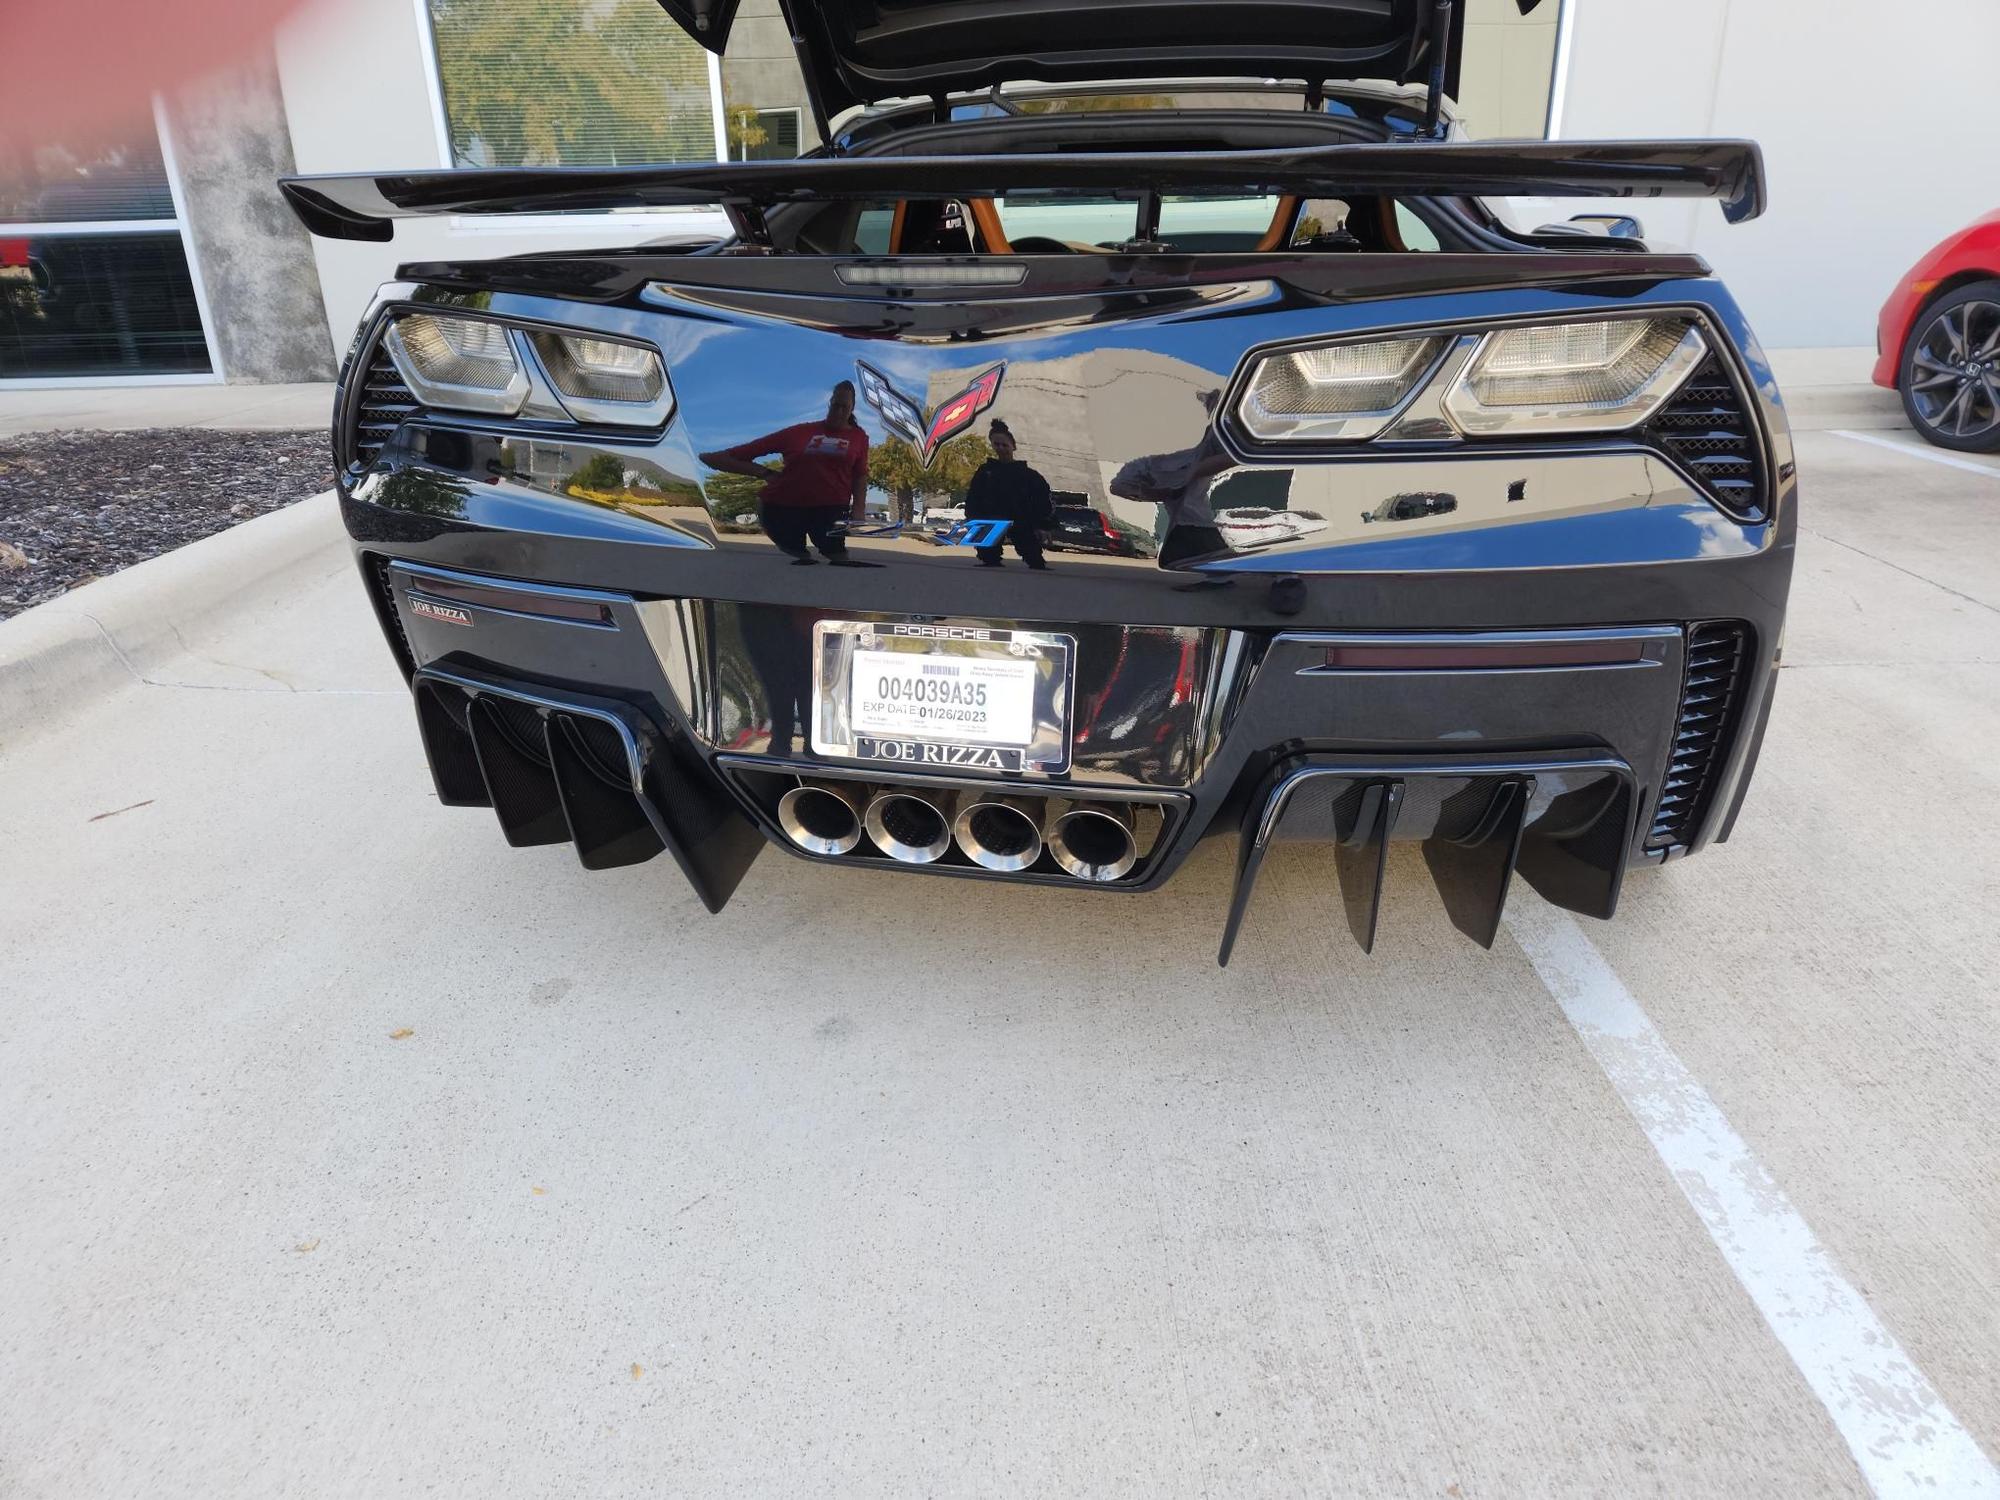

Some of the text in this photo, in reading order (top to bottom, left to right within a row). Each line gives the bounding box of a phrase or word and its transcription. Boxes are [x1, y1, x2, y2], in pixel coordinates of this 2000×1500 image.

[413, 600, 467, 621] JOE RIZZA
[894, 625, 990, 640] PORSCHE
[878, 676, 987, 707] 004039A35
[863, 701, 885, 713] EXP
[919, 706, 987, 723] 01/26/2023
[871, 740, 1005, 768] JOE RIZZA
